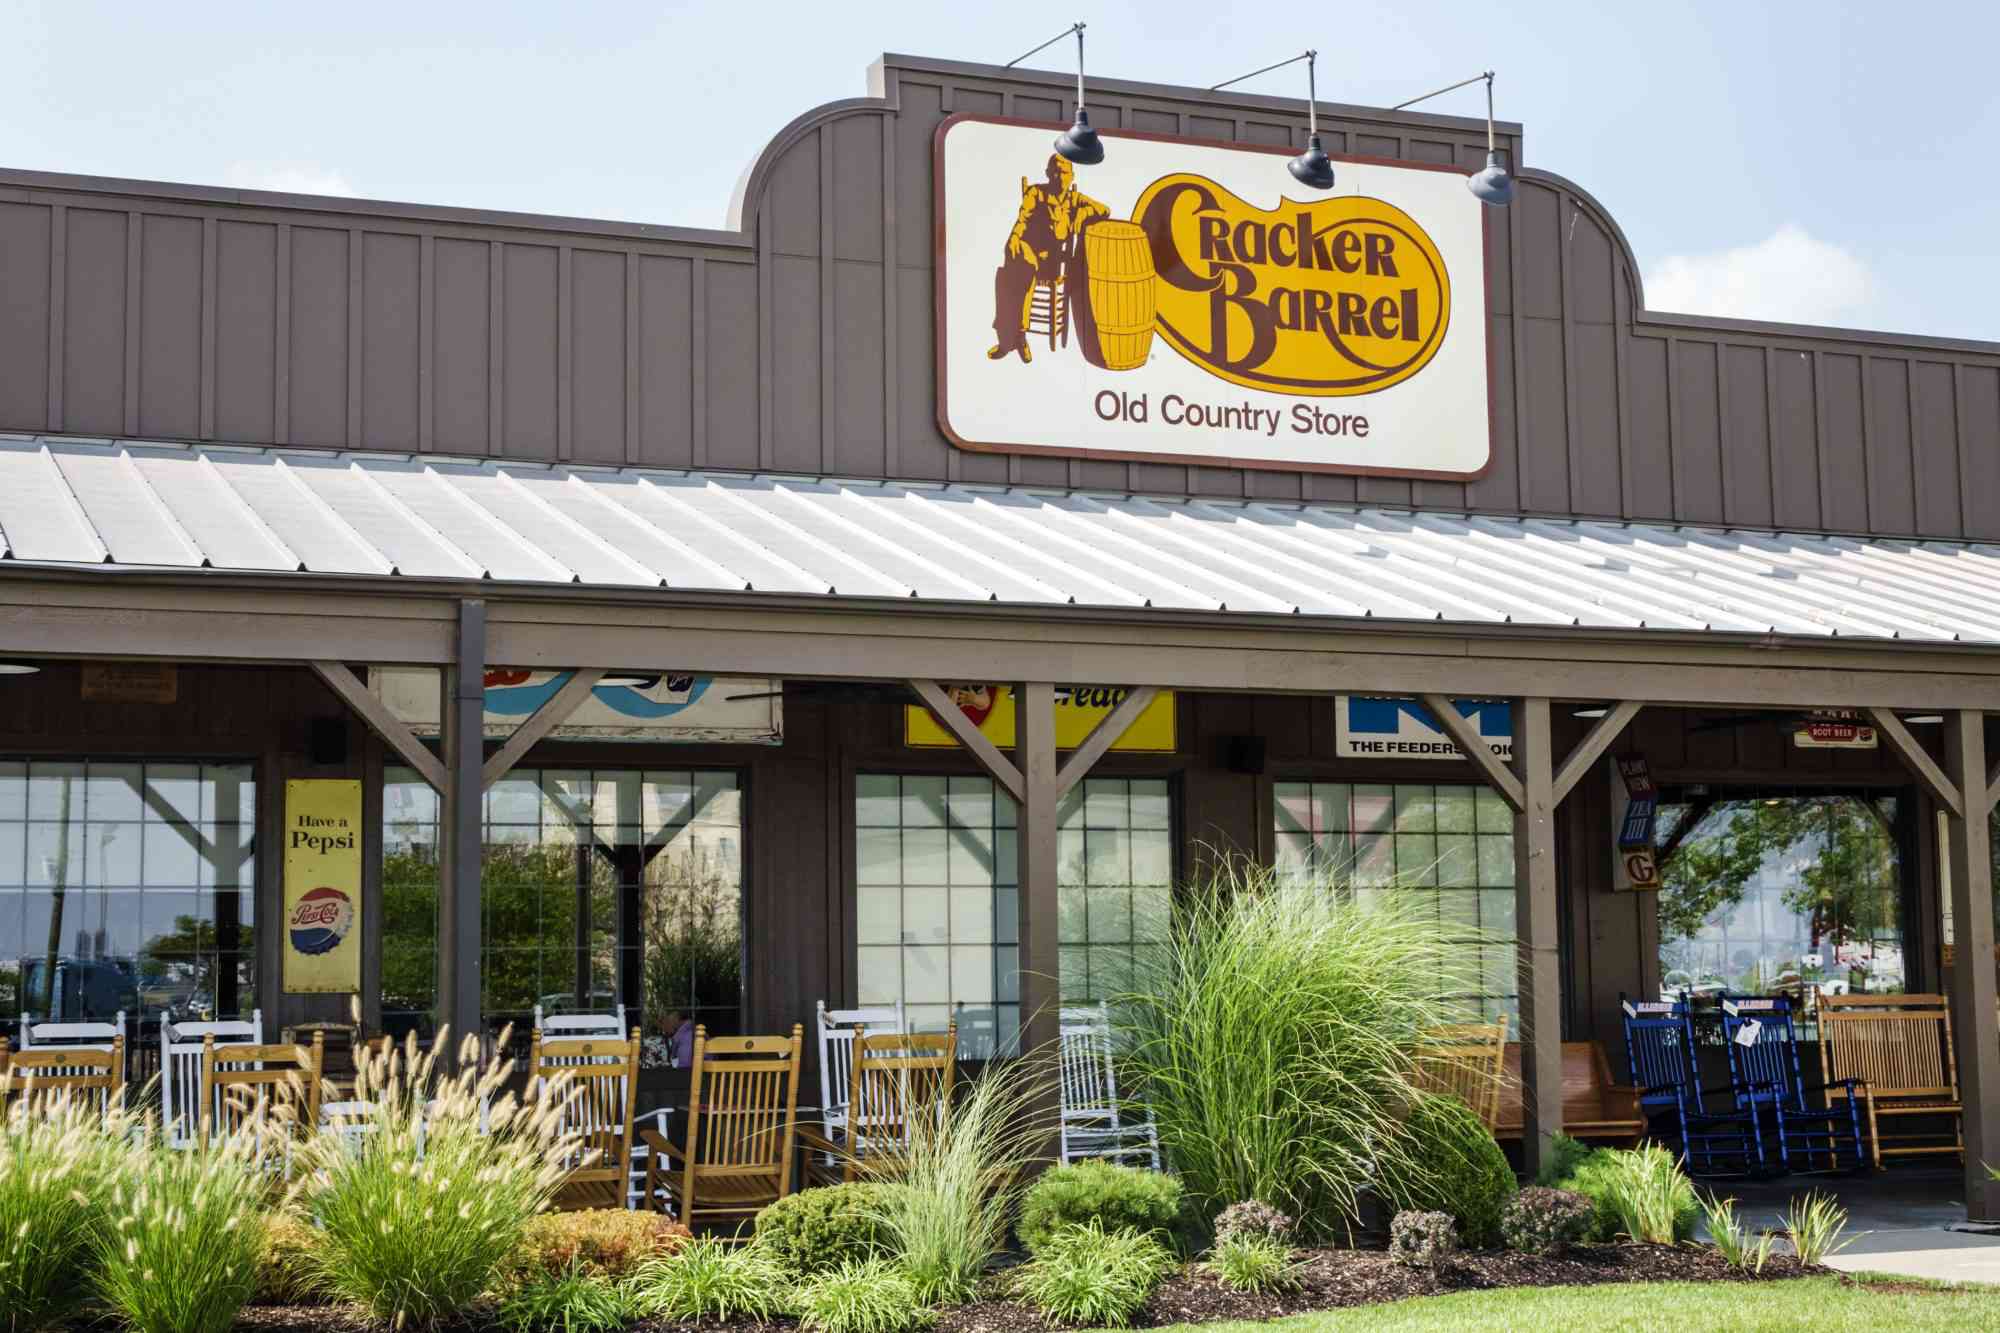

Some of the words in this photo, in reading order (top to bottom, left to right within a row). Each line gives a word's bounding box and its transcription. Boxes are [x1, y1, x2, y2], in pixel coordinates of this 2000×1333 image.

[1140, 182, 1401, 293] Cracker
[1208, 261, 1421, 371] Barrel
[1094, 389, 1149, 424] Old
[1160, 393, 1281, 437] Country
[1291, 403, 1370, 438] Store
[1348, 740, 1384, 753] THE
[297, 815, 336, 828] Have
[338, 817, 348, 828] a
[290, 830, 354, 855] Pepsi
